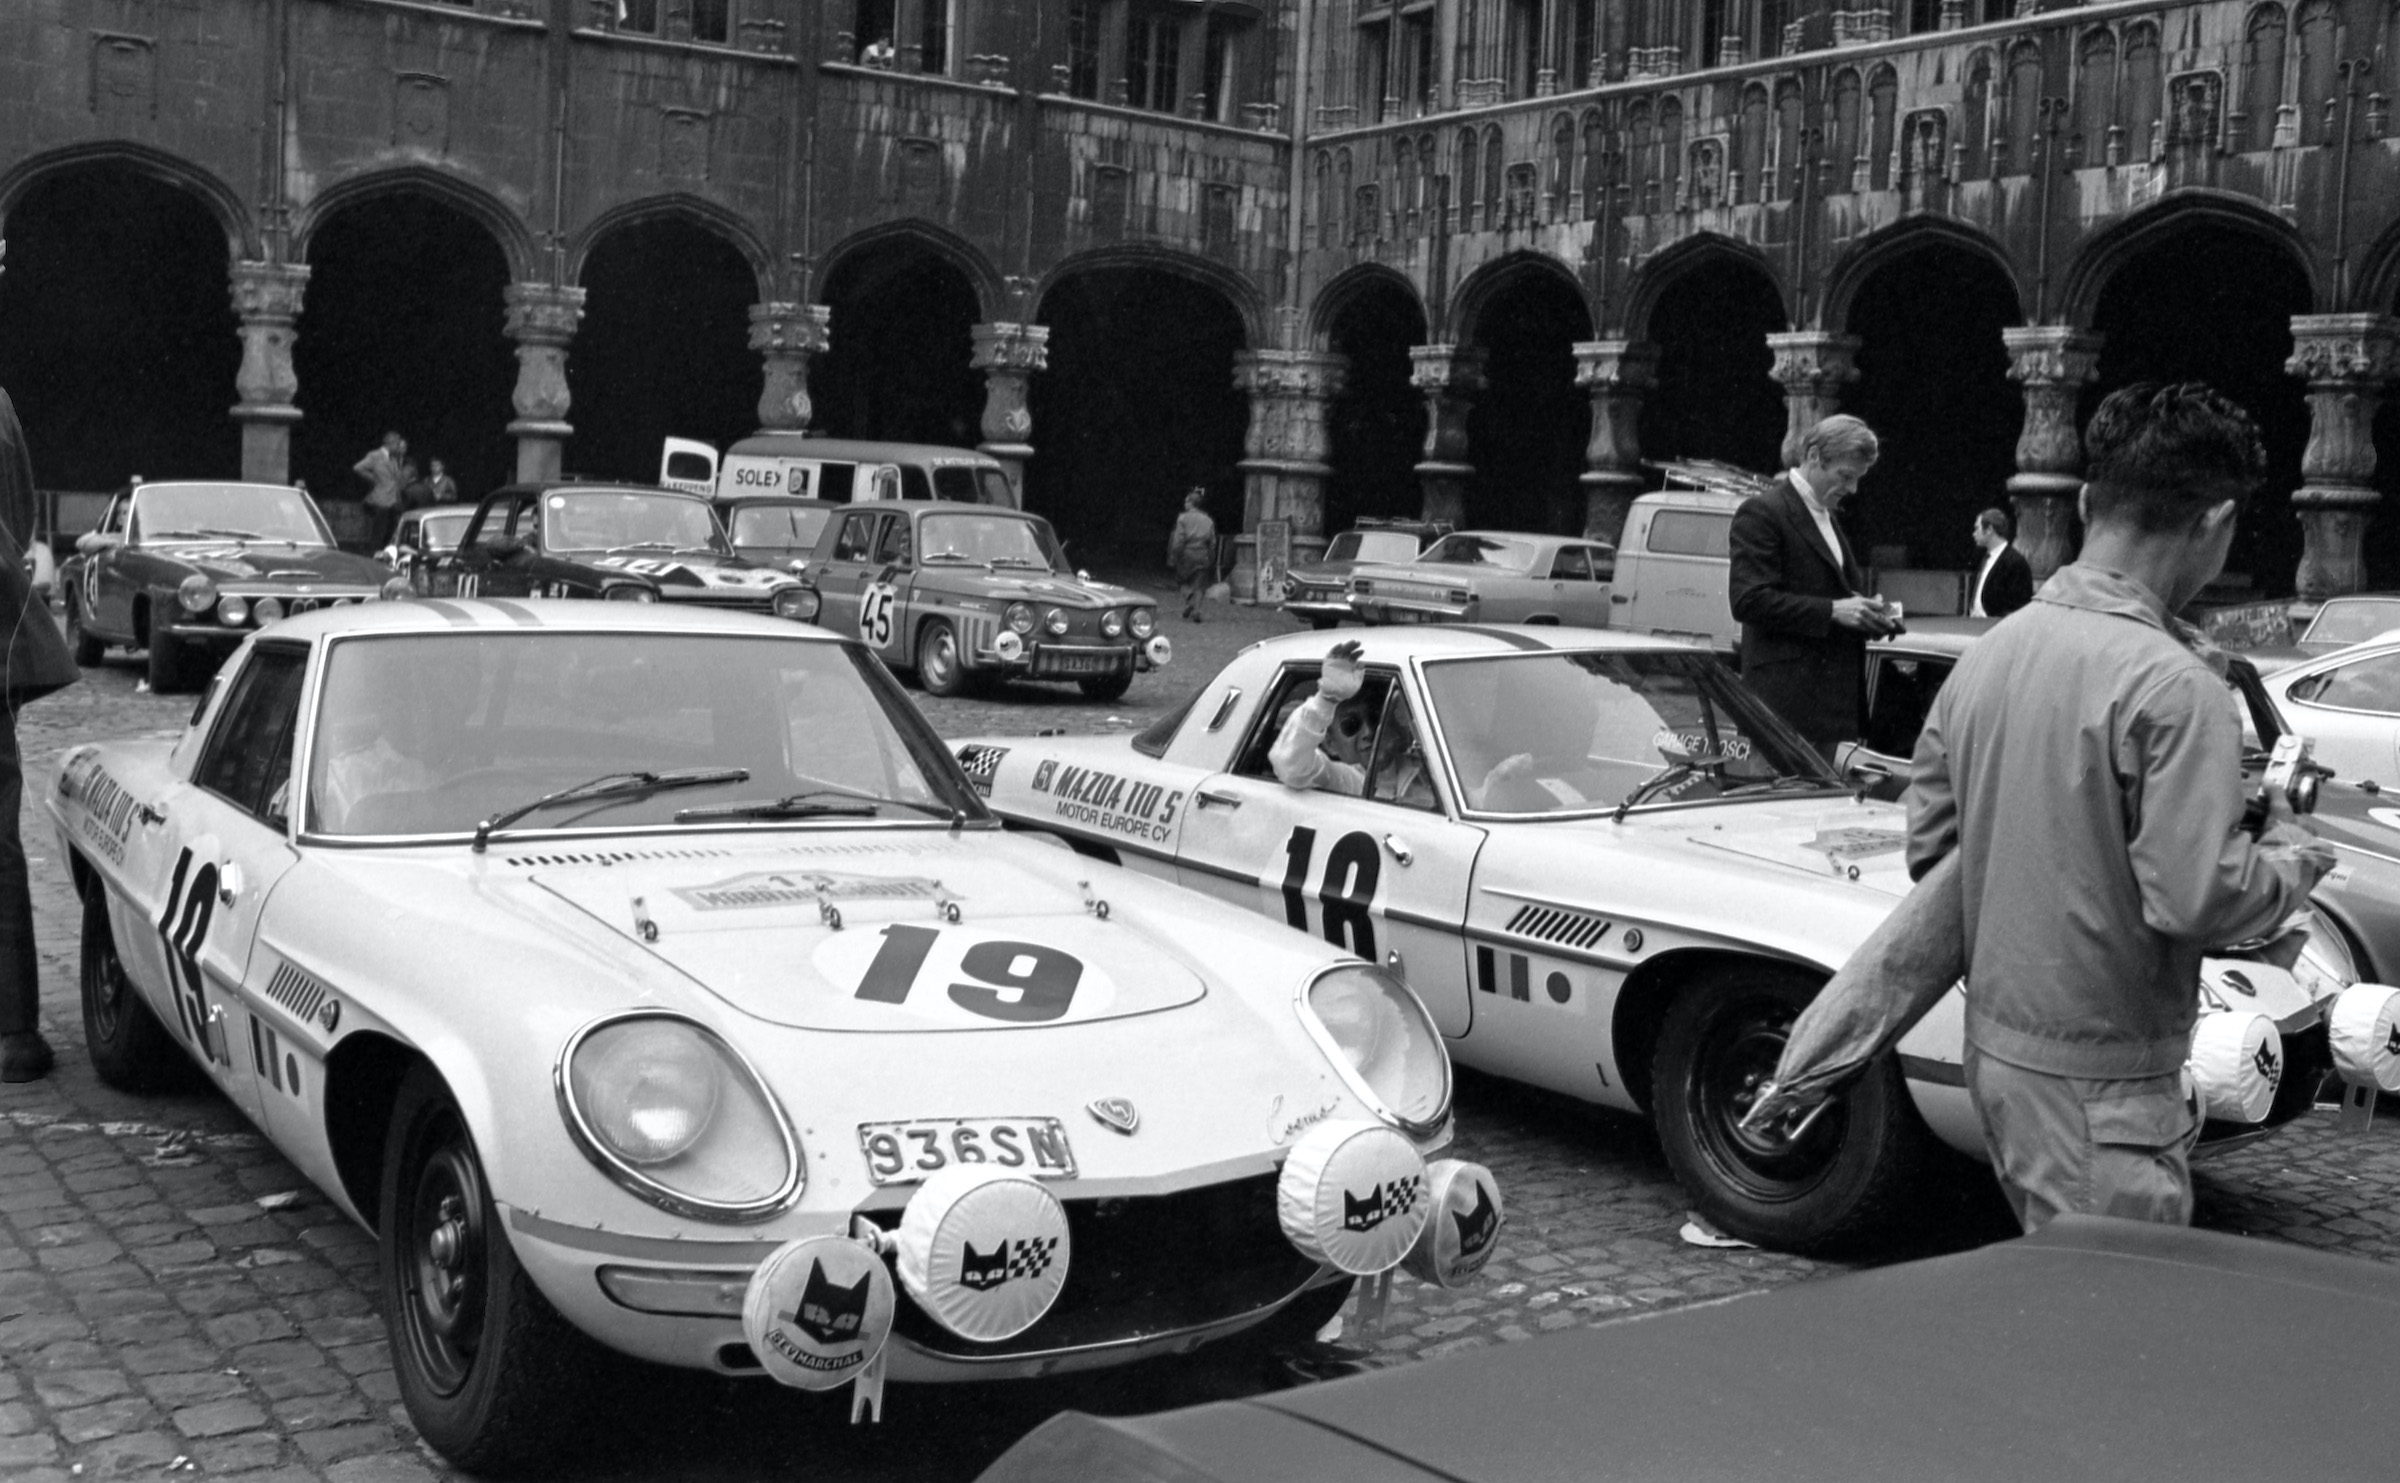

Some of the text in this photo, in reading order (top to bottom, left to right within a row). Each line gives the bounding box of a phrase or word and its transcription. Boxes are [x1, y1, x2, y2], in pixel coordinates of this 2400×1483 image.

[862, 592, 893, 644] 45
[1054, 766, 1184, 824] MAZDA 110 S
[1056, 801, 1172, 843] MOTOR EUROPE CY
[1281, 825, 1381, 964] 18
[157, 846, 217, 1063] 19
[854, 923, 1084, 1022] 19
[796, 1350, 861, 1370] MARCHAL
